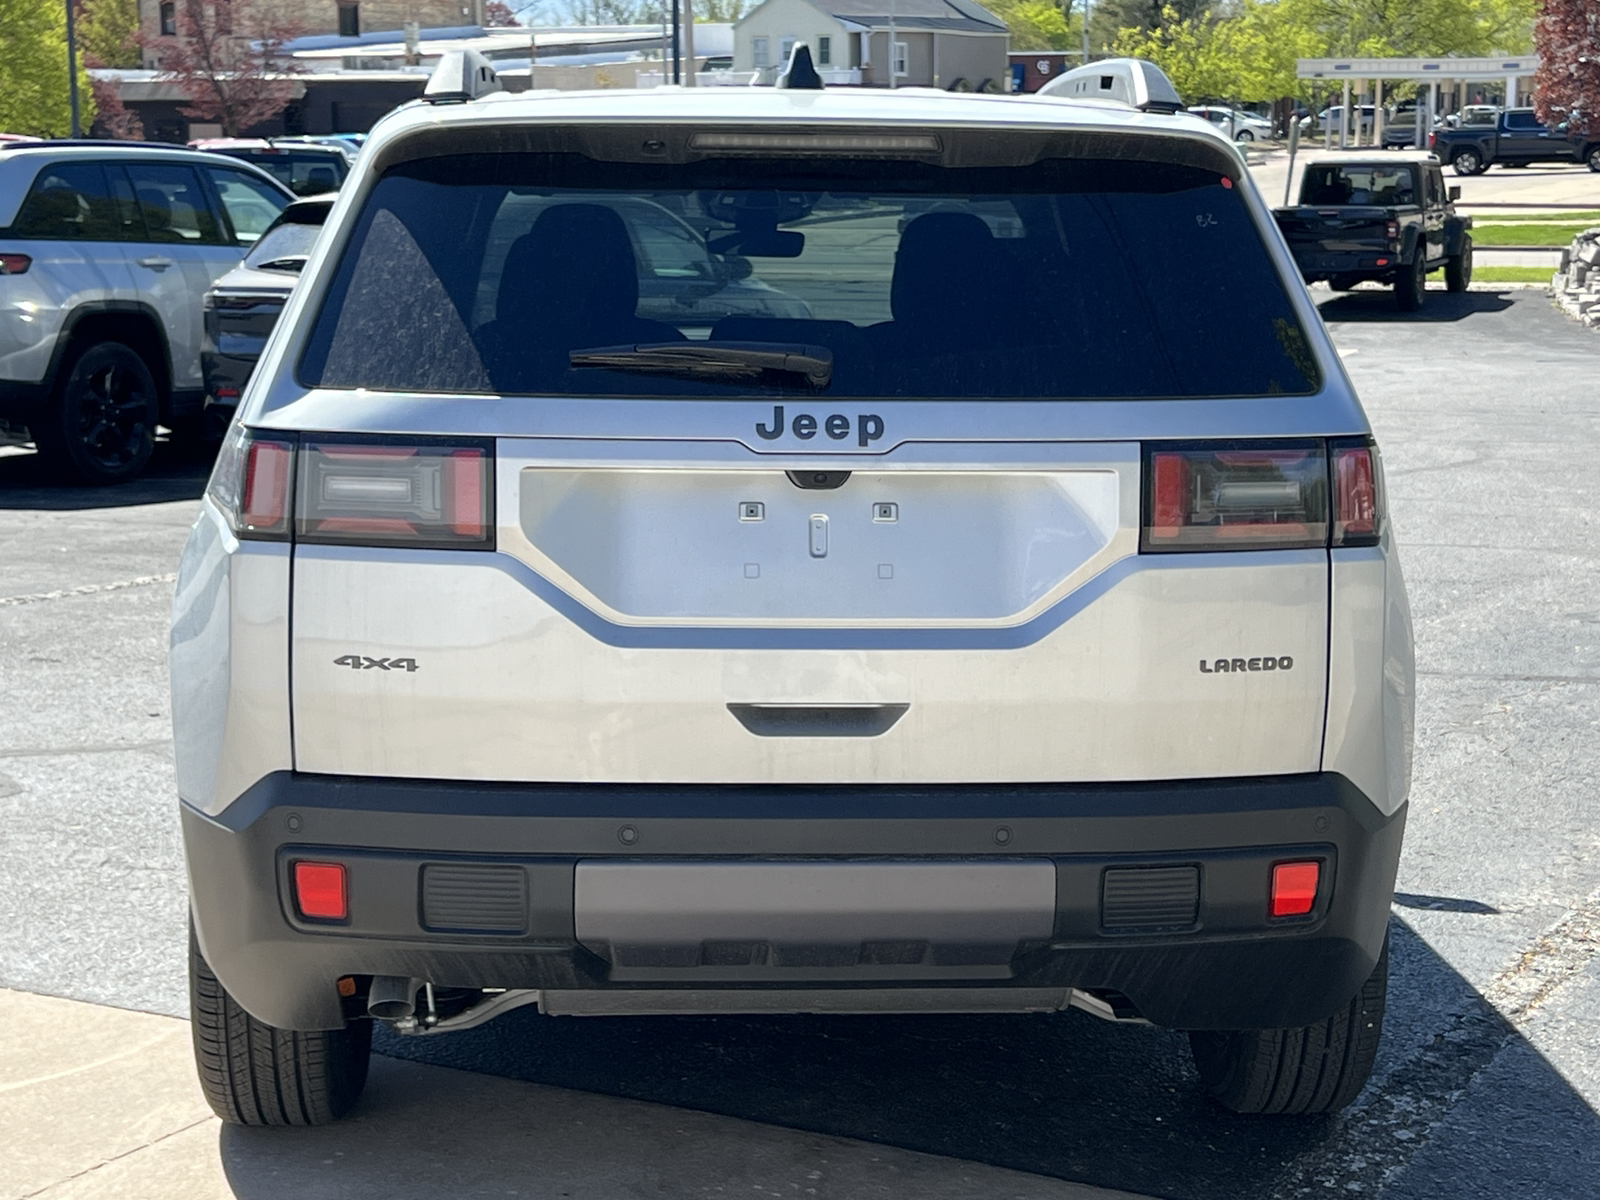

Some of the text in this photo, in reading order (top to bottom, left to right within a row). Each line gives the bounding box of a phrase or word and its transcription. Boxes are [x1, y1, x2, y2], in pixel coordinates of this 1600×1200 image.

[755, 405, 885, 447] Jeep
[333, 655, 420, 672] 4x4
[1199, 656, 1294, 673] LAREDO
